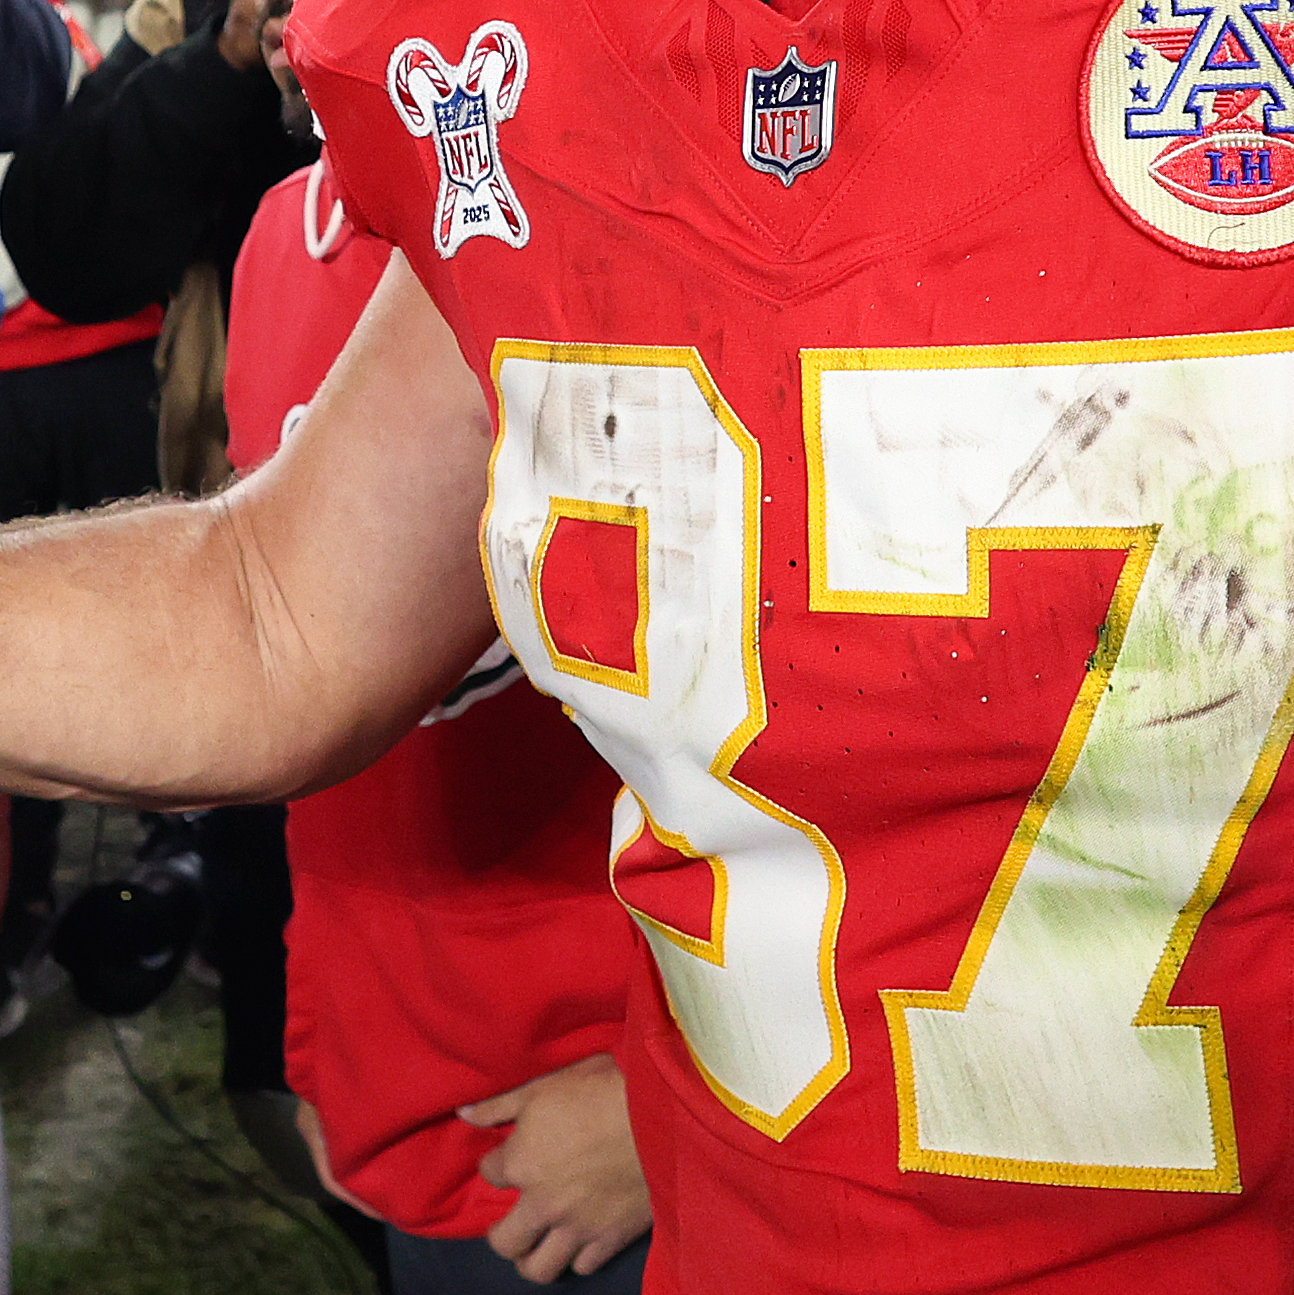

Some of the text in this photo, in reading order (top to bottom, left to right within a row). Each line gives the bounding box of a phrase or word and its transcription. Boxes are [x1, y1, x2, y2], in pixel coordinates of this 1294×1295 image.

[445, 131, 489, 180] NFL
[758, 109, 818, 160] NFL
[1205, 150, 1272, 187] LH
[463, 204, 491, 225] 2025
